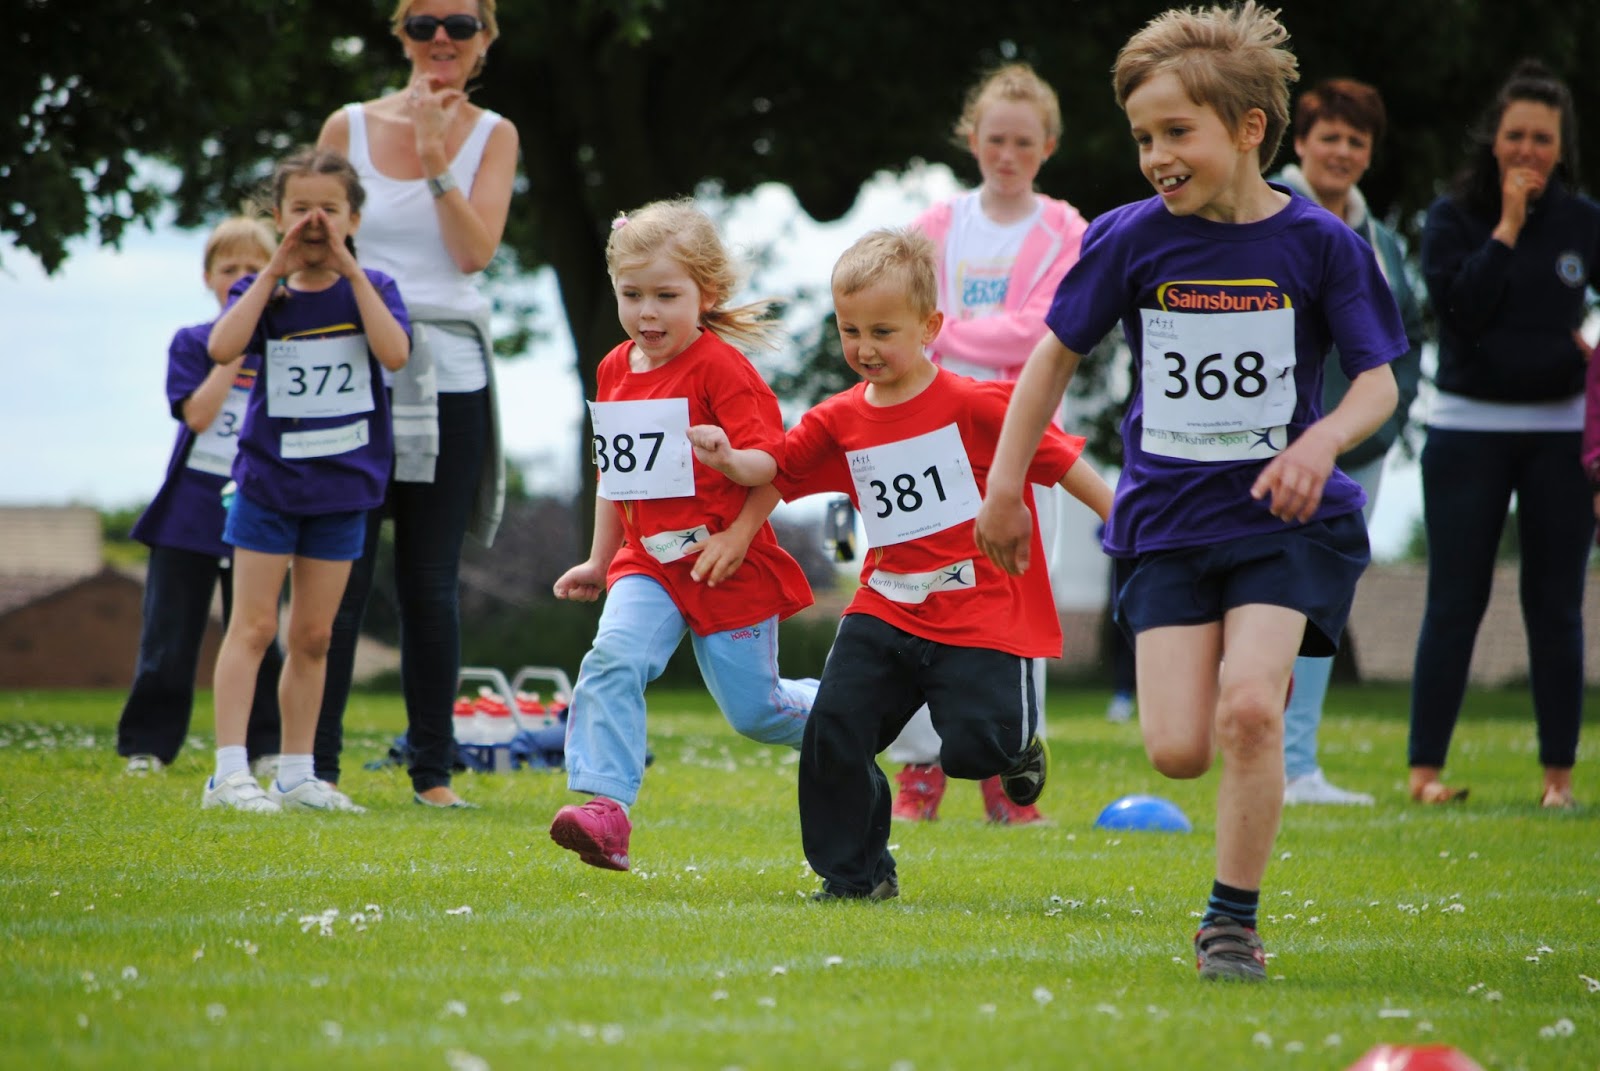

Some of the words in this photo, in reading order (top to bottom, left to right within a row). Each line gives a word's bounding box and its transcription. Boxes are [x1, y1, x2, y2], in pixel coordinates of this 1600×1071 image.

[1167, 288, 1279, 312] Sainsbury's
[288, 363, 354, 396] 372
[1164, 351, 1268, 401] 368
[216, 412, 239, 437] 3
[1170, 431, 1216, 445] Yorkshire
[1218, 434, 1250, 447] Sport
[594, 432, 665, 473] 387
[869, 464, 947, 519] 381
[897, 522, 942, 538] www.quadkids.org
[655, 538, 679, 554] Sport
[869, 577, 892, 588] North
[922, 574, 943, 591] Sprt
